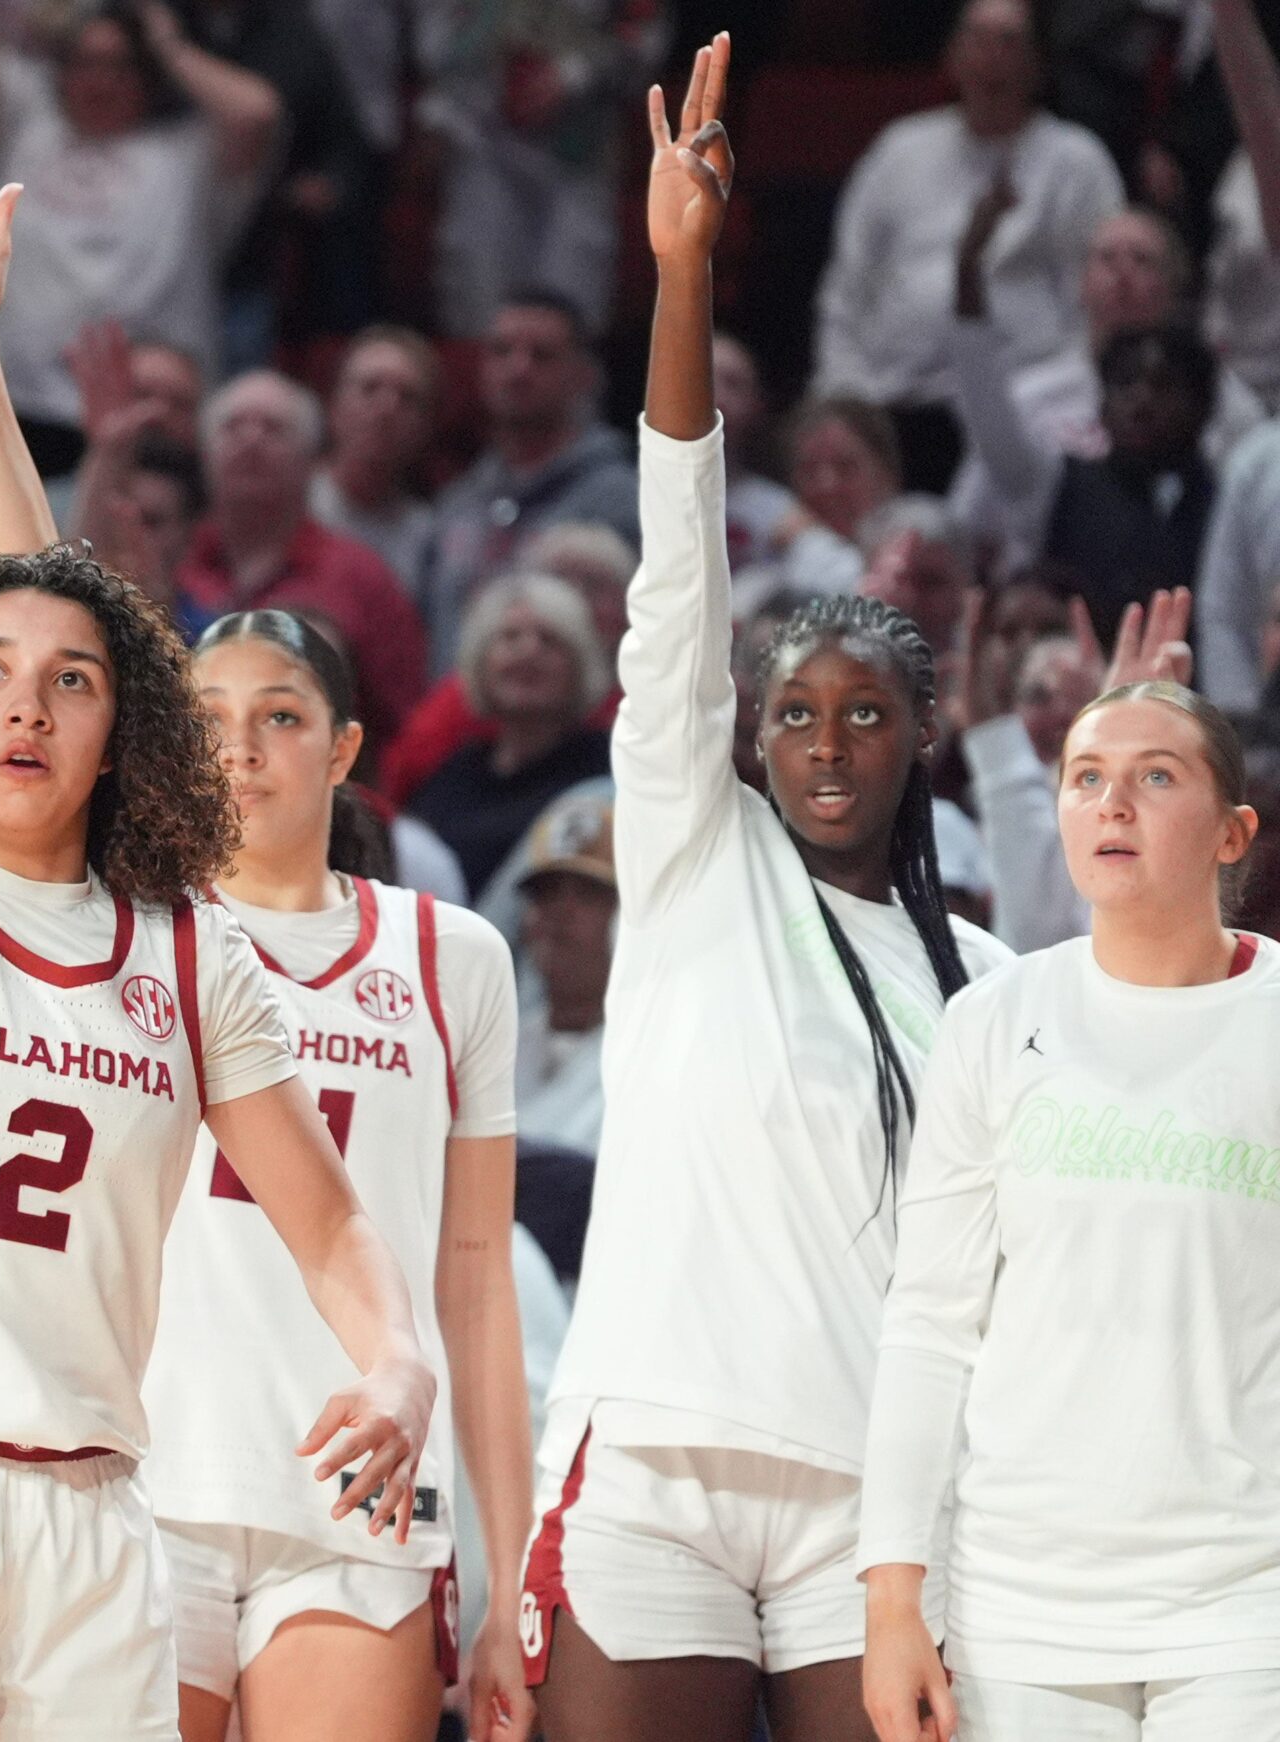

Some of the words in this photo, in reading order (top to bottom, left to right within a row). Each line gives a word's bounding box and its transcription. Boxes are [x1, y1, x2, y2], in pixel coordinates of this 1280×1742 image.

[123, 975, 175, 1040] SEC
[356, 969, 413, 1021] SEC
[296, 1029, 412, 1078] HOMA
[1162, 1172, 1280, 1204] BASKETBAL
